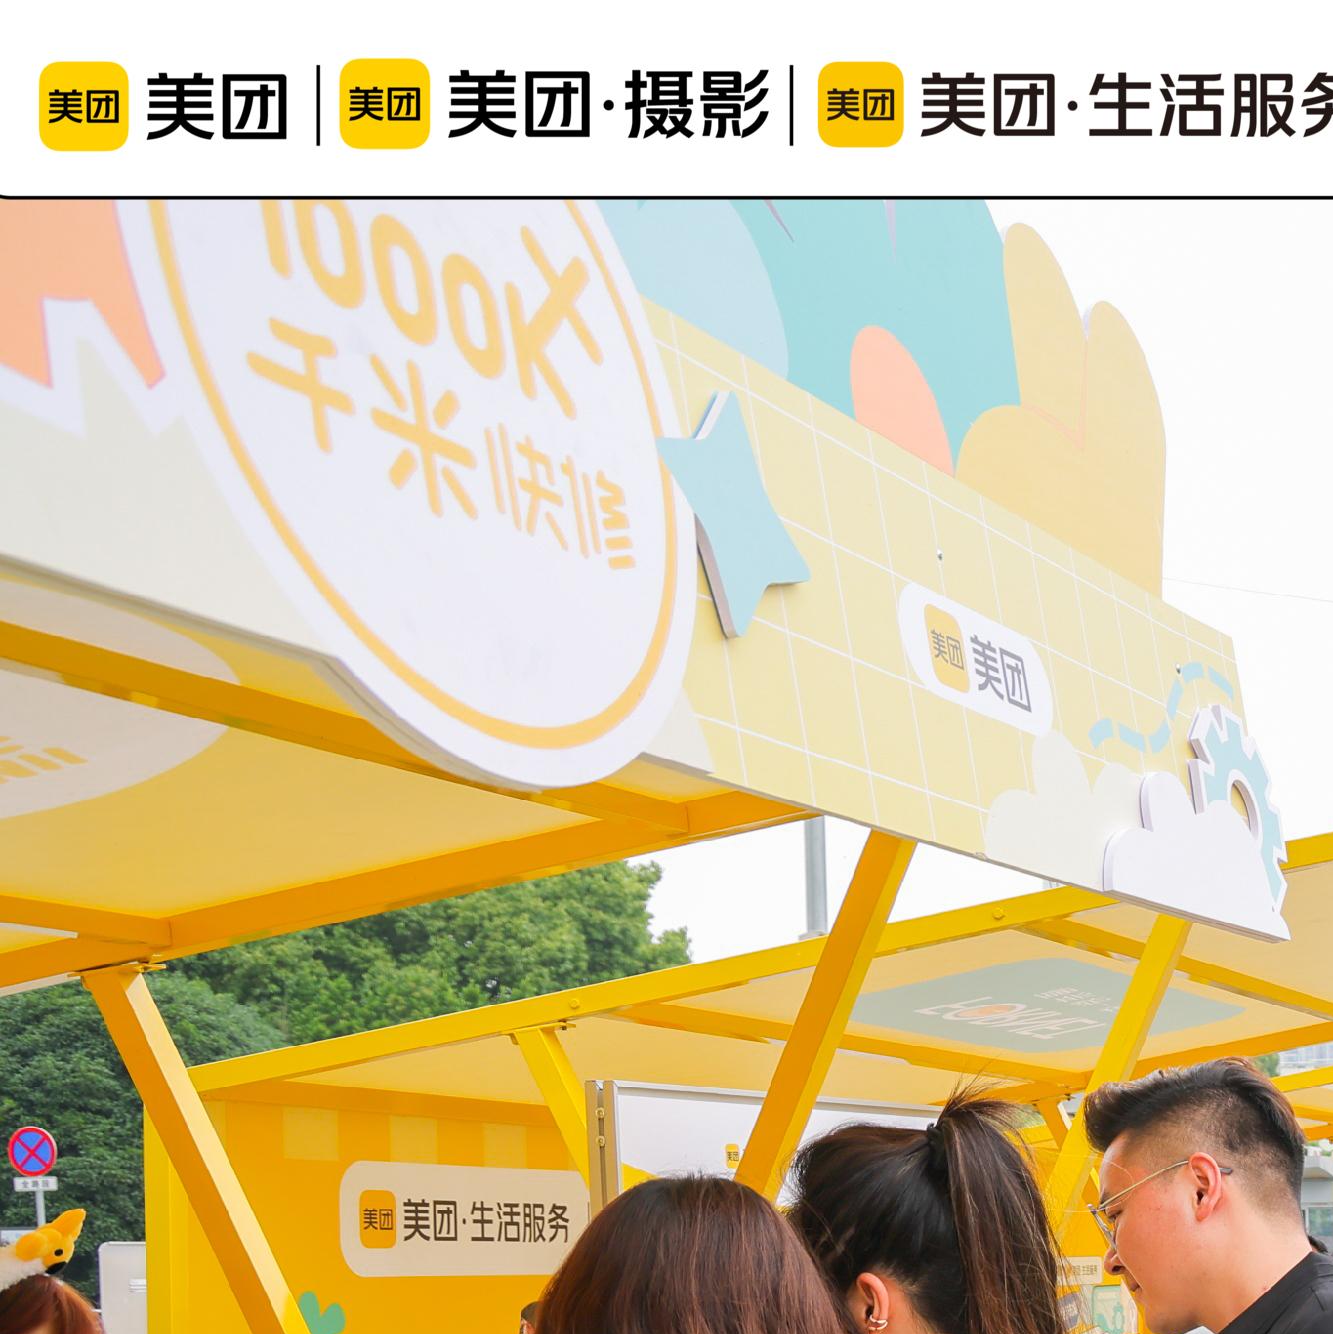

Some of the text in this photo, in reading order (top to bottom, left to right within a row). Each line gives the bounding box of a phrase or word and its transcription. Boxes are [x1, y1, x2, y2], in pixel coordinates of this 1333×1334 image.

[245, 317, 637, 570] 千米快修
[930, 628, 1033, 714] 美团 美团
[362, 1198, 570, 1243] 美团 美团·生活服务
